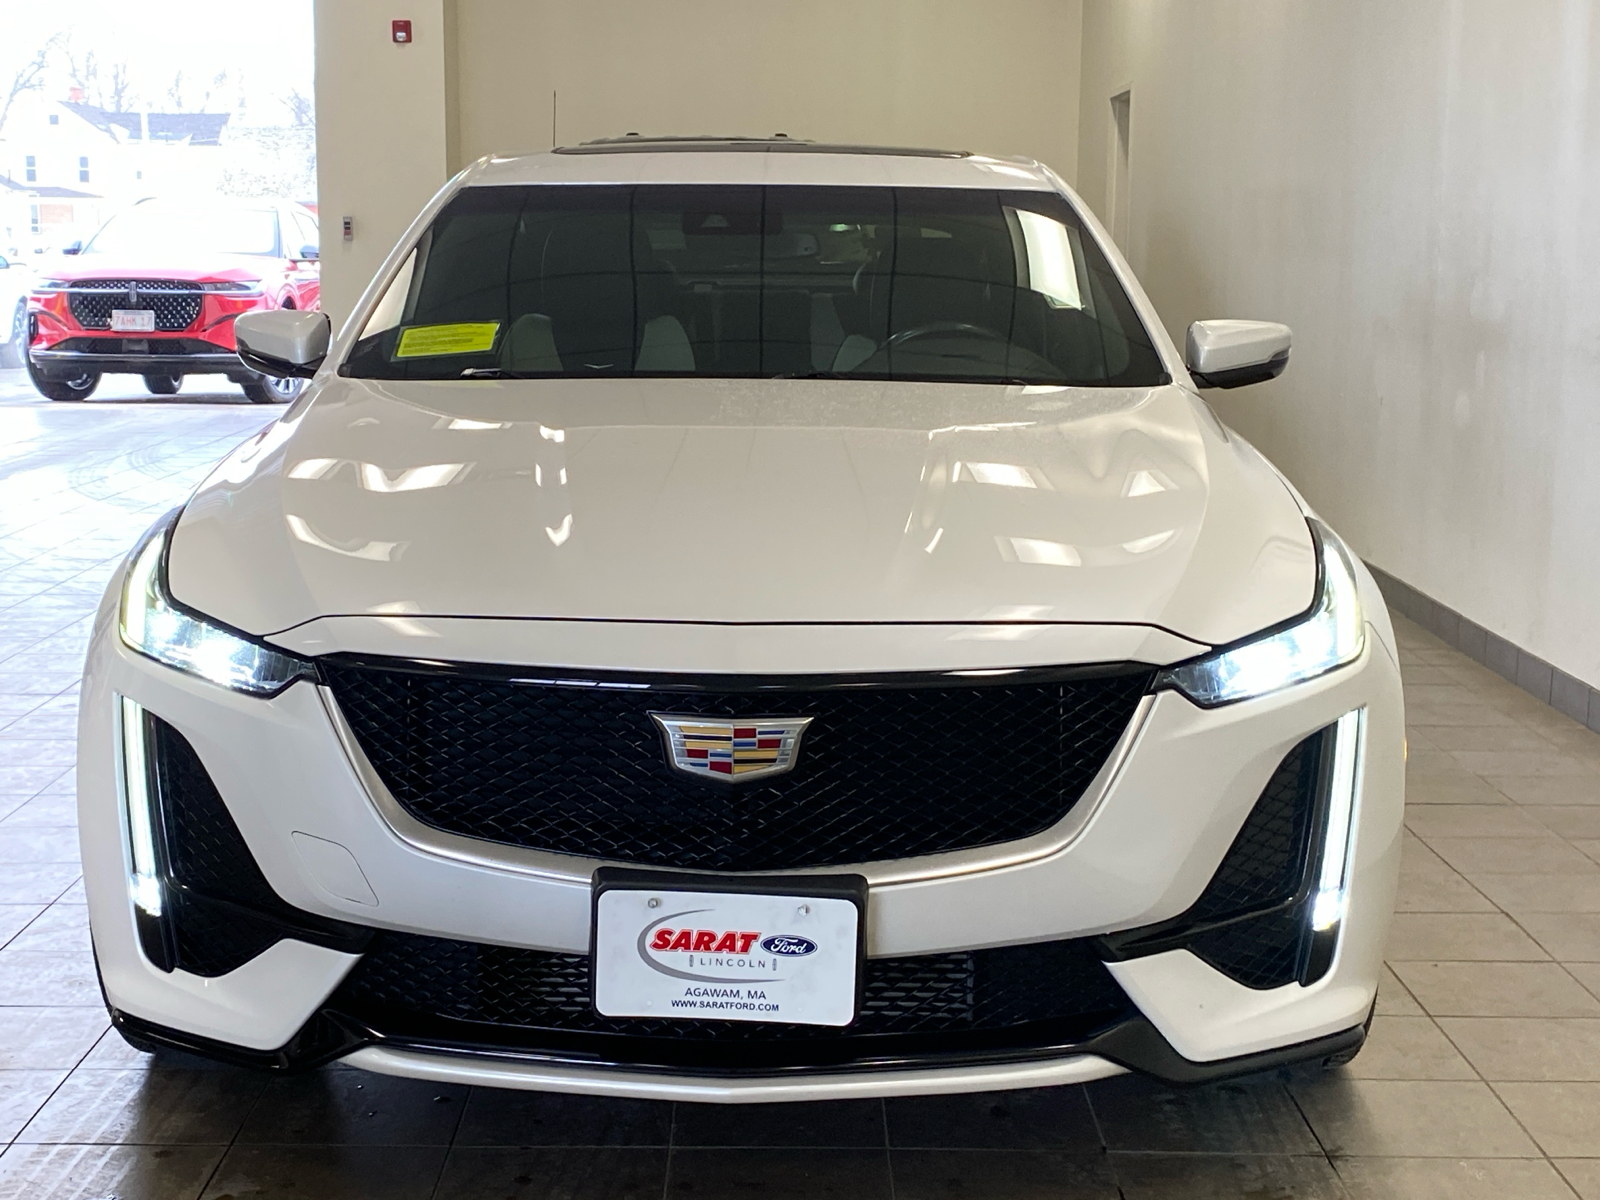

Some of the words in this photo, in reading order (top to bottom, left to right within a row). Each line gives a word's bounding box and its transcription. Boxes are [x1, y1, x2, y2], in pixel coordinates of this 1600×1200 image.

[650, 928, 761, 955] SARAT
[770, 937, 808, 954] Ford
[700, 957, 766, 968] LINCOLN
[684, 987, 744, 1000] AGAWAM,
[747, 990, 767, 1000] MA
[671, 1000, 780, 1012] WWW.SARATFORD.COM
